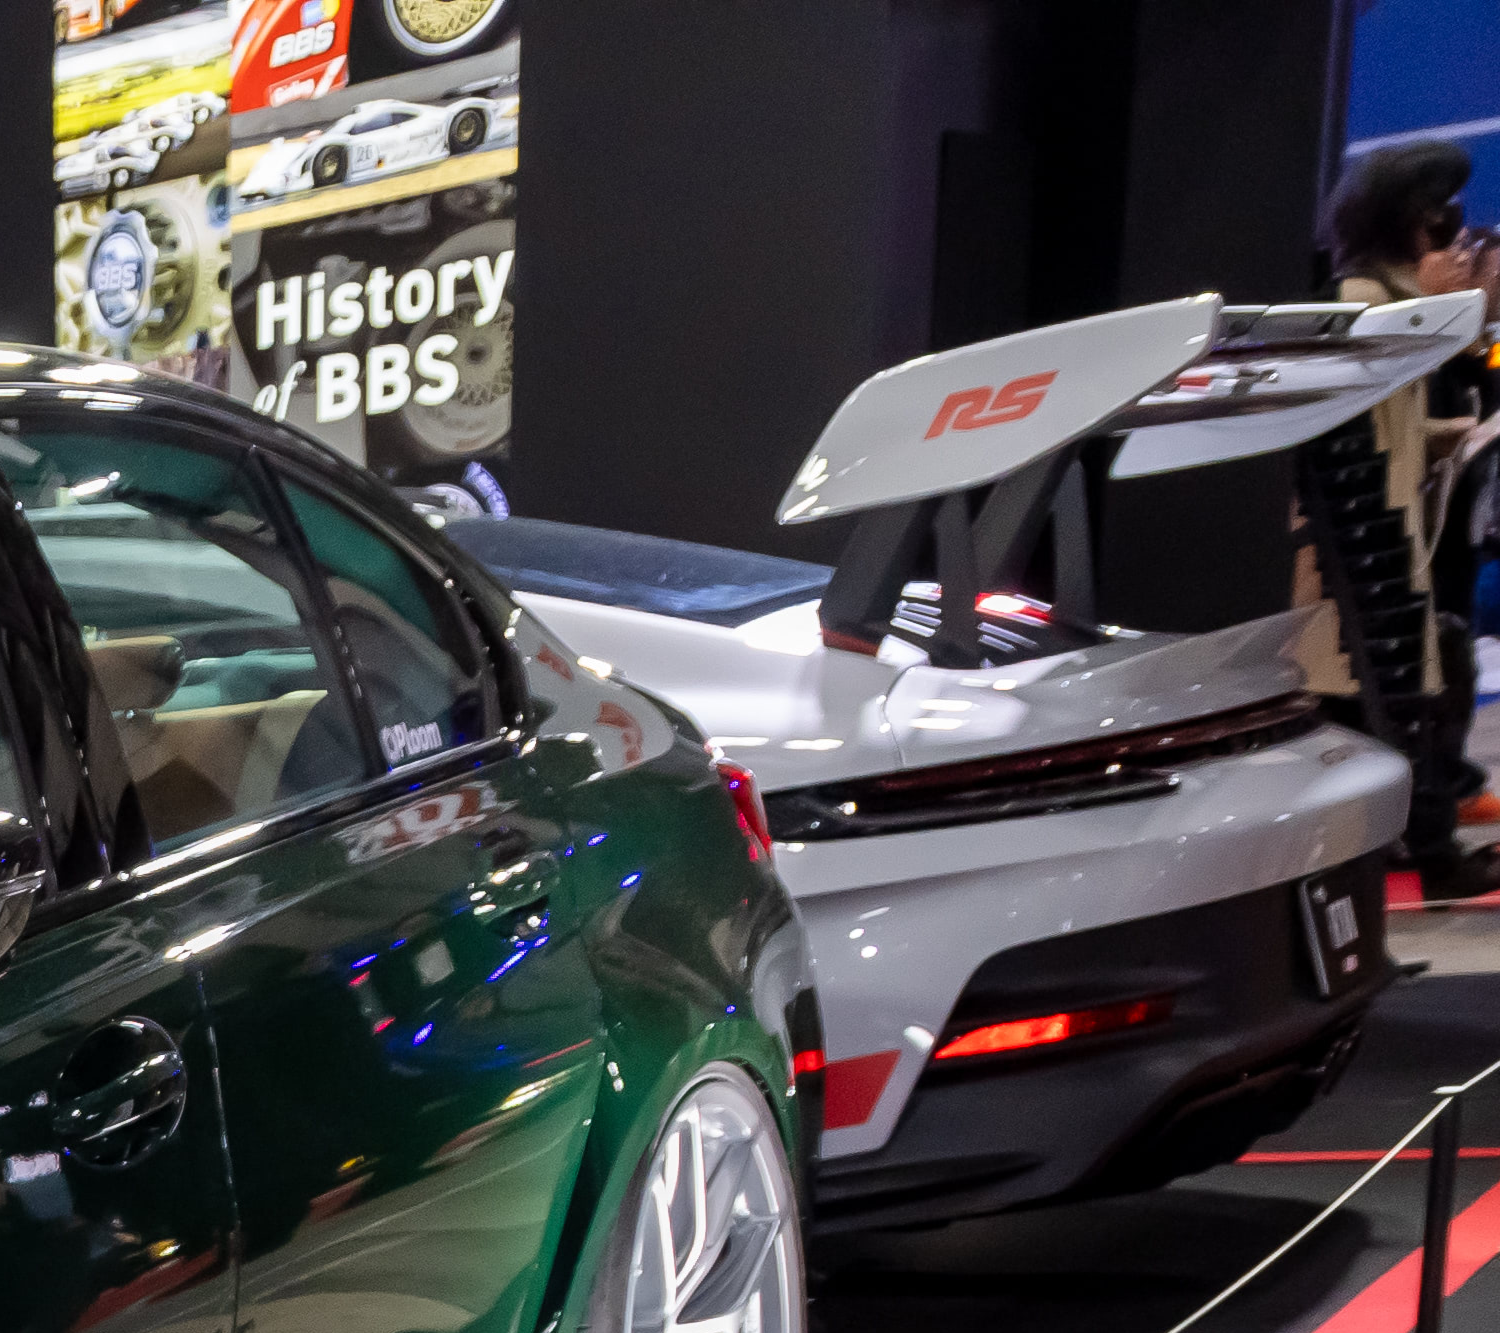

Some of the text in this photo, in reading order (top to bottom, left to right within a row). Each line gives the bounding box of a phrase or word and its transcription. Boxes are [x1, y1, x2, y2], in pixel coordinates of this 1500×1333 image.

[269, 20, 336, 69] BBS
[255, 249, 516, 351] History
[253, 333, 460, 424] of BBS
[923, 368, 1061, 441] RS
